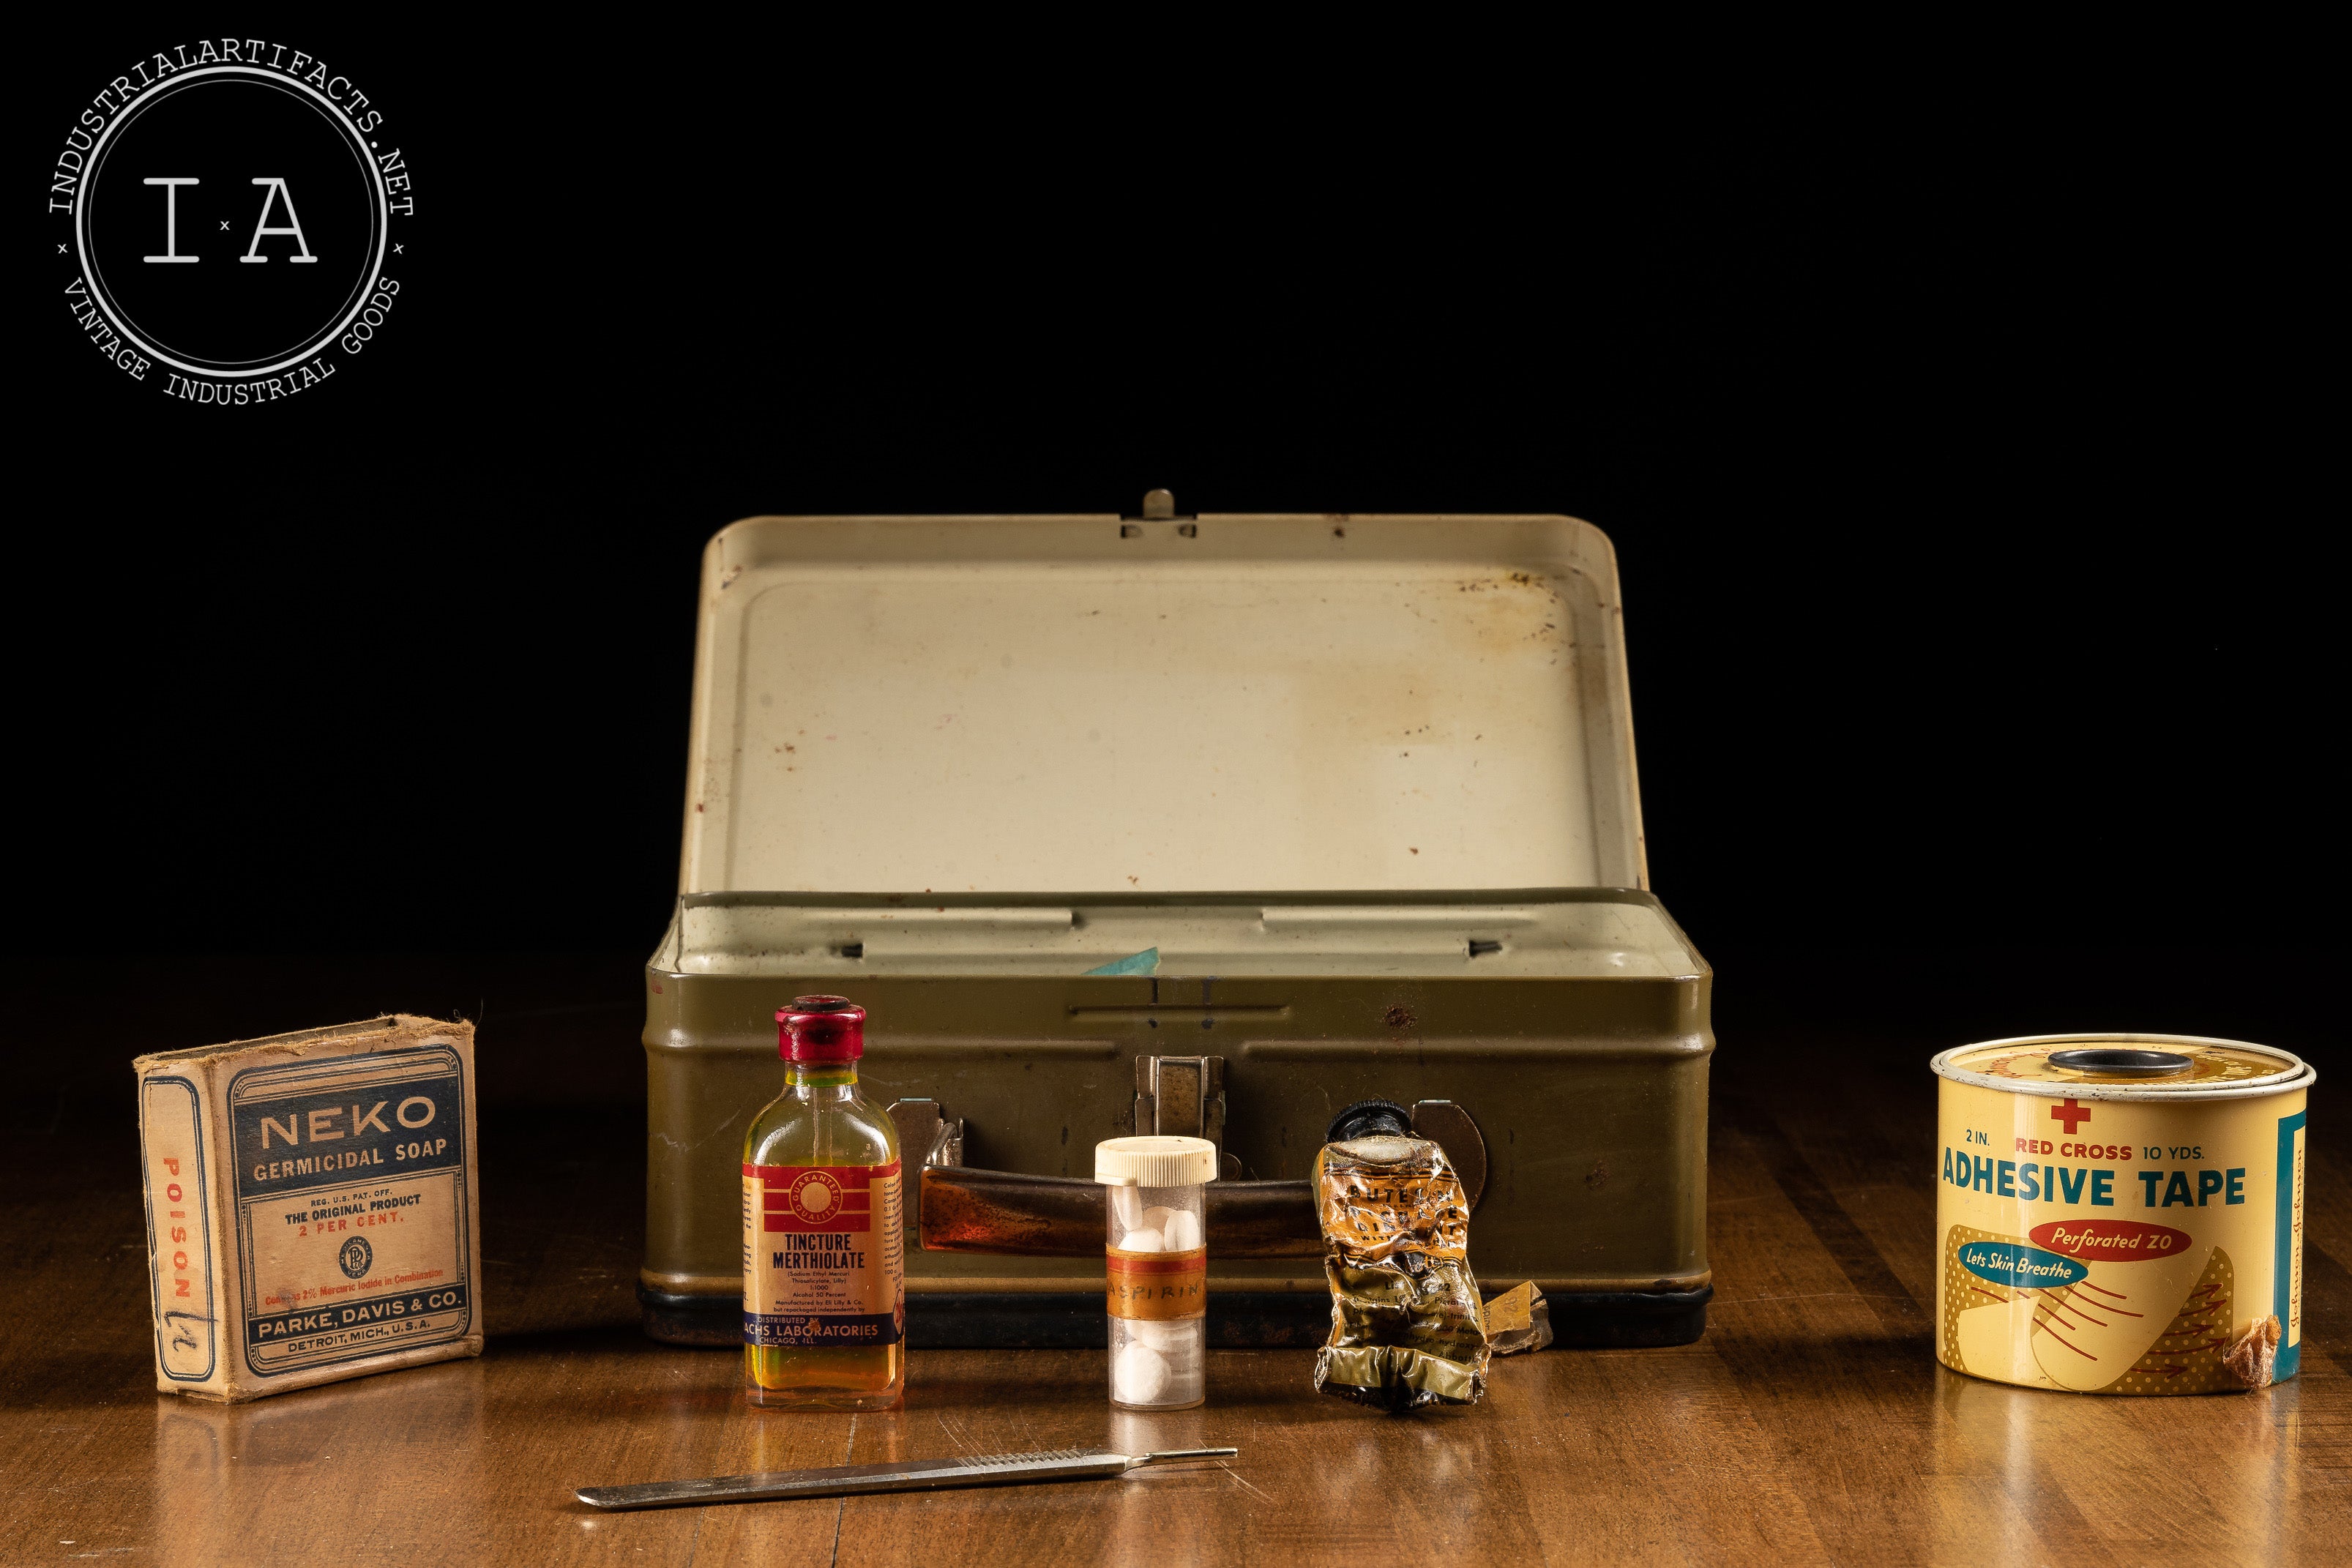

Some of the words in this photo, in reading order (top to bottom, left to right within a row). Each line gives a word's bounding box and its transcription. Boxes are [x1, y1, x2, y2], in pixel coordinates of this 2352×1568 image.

[261, 1097, 436, 1149] NEKO
[1966, 1128, 1973, 1142] 2
[1974, 1131, 1990, 1146] IN.
[254, 1149, 384, 1181] GERMICIDAL
[395, 1139, 447, 1160] SOAP
[2016, 1138, 2053, 1156] RED
[2060, 1143, 2132, 1161] CROSS
[2143, 1146, 2162, 1160] 10
[2170, 1146, 2205, 1160] YDS.
[793, 1174, 840, 1201] GUARANTEED
[1943, 1147, 2114, 1206] ADHESIVE
[2139, 1168, 2246, 1207] TAPE
[353, 1192, 371, 1201] PAT.
[374, 1189, 392, 1197] OFF.
[285, 1212, 307, 1225] THE
[312, 1203, 366, 1221] ORIGINAL
[370, 1194, 422, 1211] PRODUCT
[796, 1204, 836, 1220] QUALITY
[163, 1157, 190, 1297] POISON
[299, 1225, 307, 1236] 2
[317, 1219, 348, 1234] PER
[356, 1212, 404, 1228] CENT.
[784, 1233, 852, 1251] TINCTURE
[2050, 1228, 2141, 1253] Perforated
[772, 1252, 865, 1269] MERTHIOLATE
[1966, 1248, 1986, 1267] Lets
[1987, 1252, 2014, 1272] Skin
[2017, 1258, 2072, 1279] Breathe
[265, 1293, 301, 1305] Conns
[303, 1288, 317, 1299] 2%
[320, 1283, 356, 1296] Mercuric
[358, 1278, 383, 1291] Iodide
[385, 1277, 392, 1286] in
[395, 1269, 444, 1283] Combination
[1108, 1282, 1198, 1299] ASPIRIN
[258, 1313, 338, 1338] PARKE,
[342, 1299, 405, 1323] DAVIS
[411, 1299, 422, 1311] &
[429, 1291, 461, 1308] CO.
[759, 1337, 798, 1345] CHICAGO,
[777, 1325, 878, 1336] LABORATORIES
[288, 1334, 347, 1353] DETROIT,
